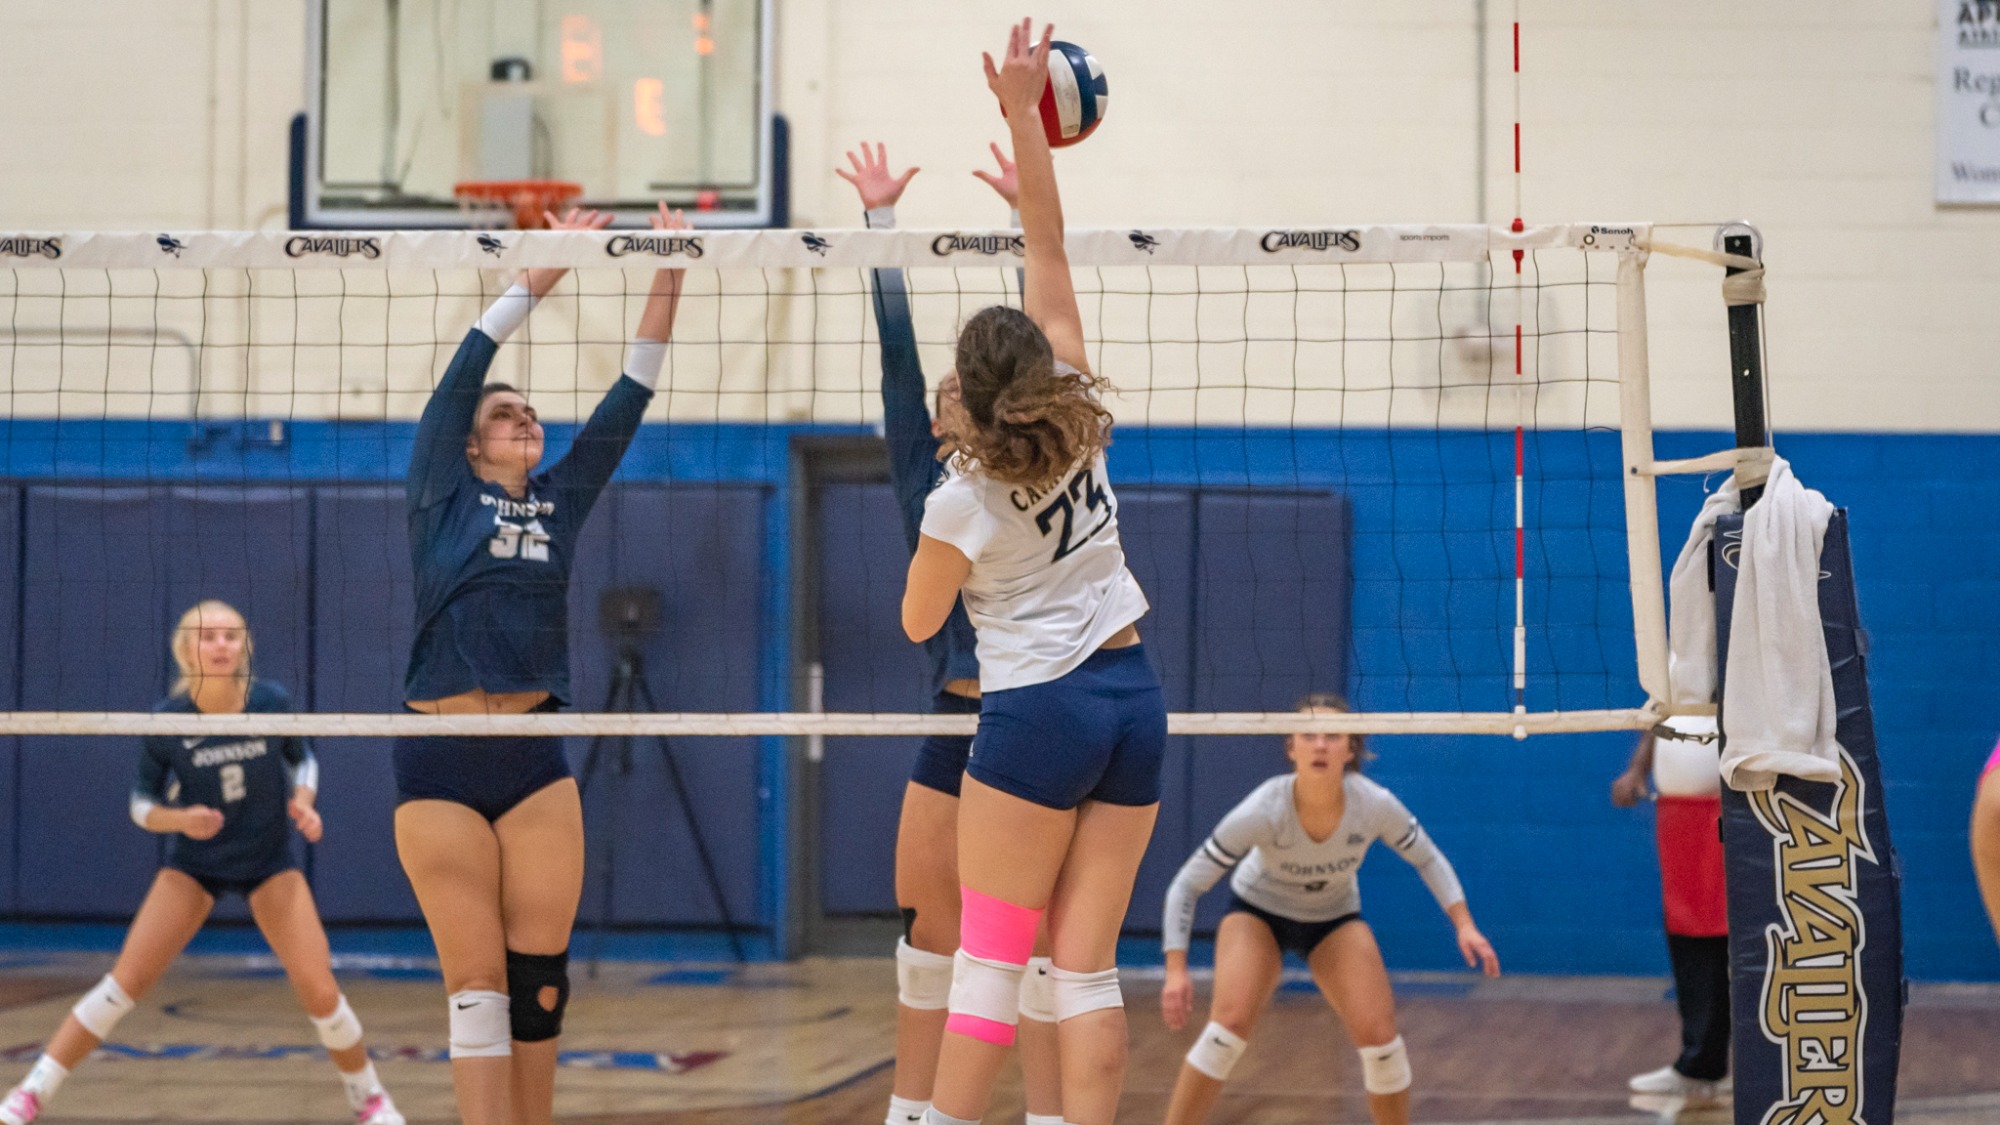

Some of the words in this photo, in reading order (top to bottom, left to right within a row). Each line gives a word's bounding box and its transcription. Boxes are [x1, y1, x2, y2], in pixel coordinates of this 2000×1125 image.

[1261, 229, 1360, 253] CAVALIERS
[1600, 227, 1634, 235] Senoh
[285, 236, 381, 258] CAVALIERS
[606, 235, 704, 258] CAVALIERS
[1035, 468, 1112, 565] 23
[192, 739, 267, 767] JOHNSON
[220, 764, 247, 803] 2
[1750, 744, 1878, 1125] CAVALIER
